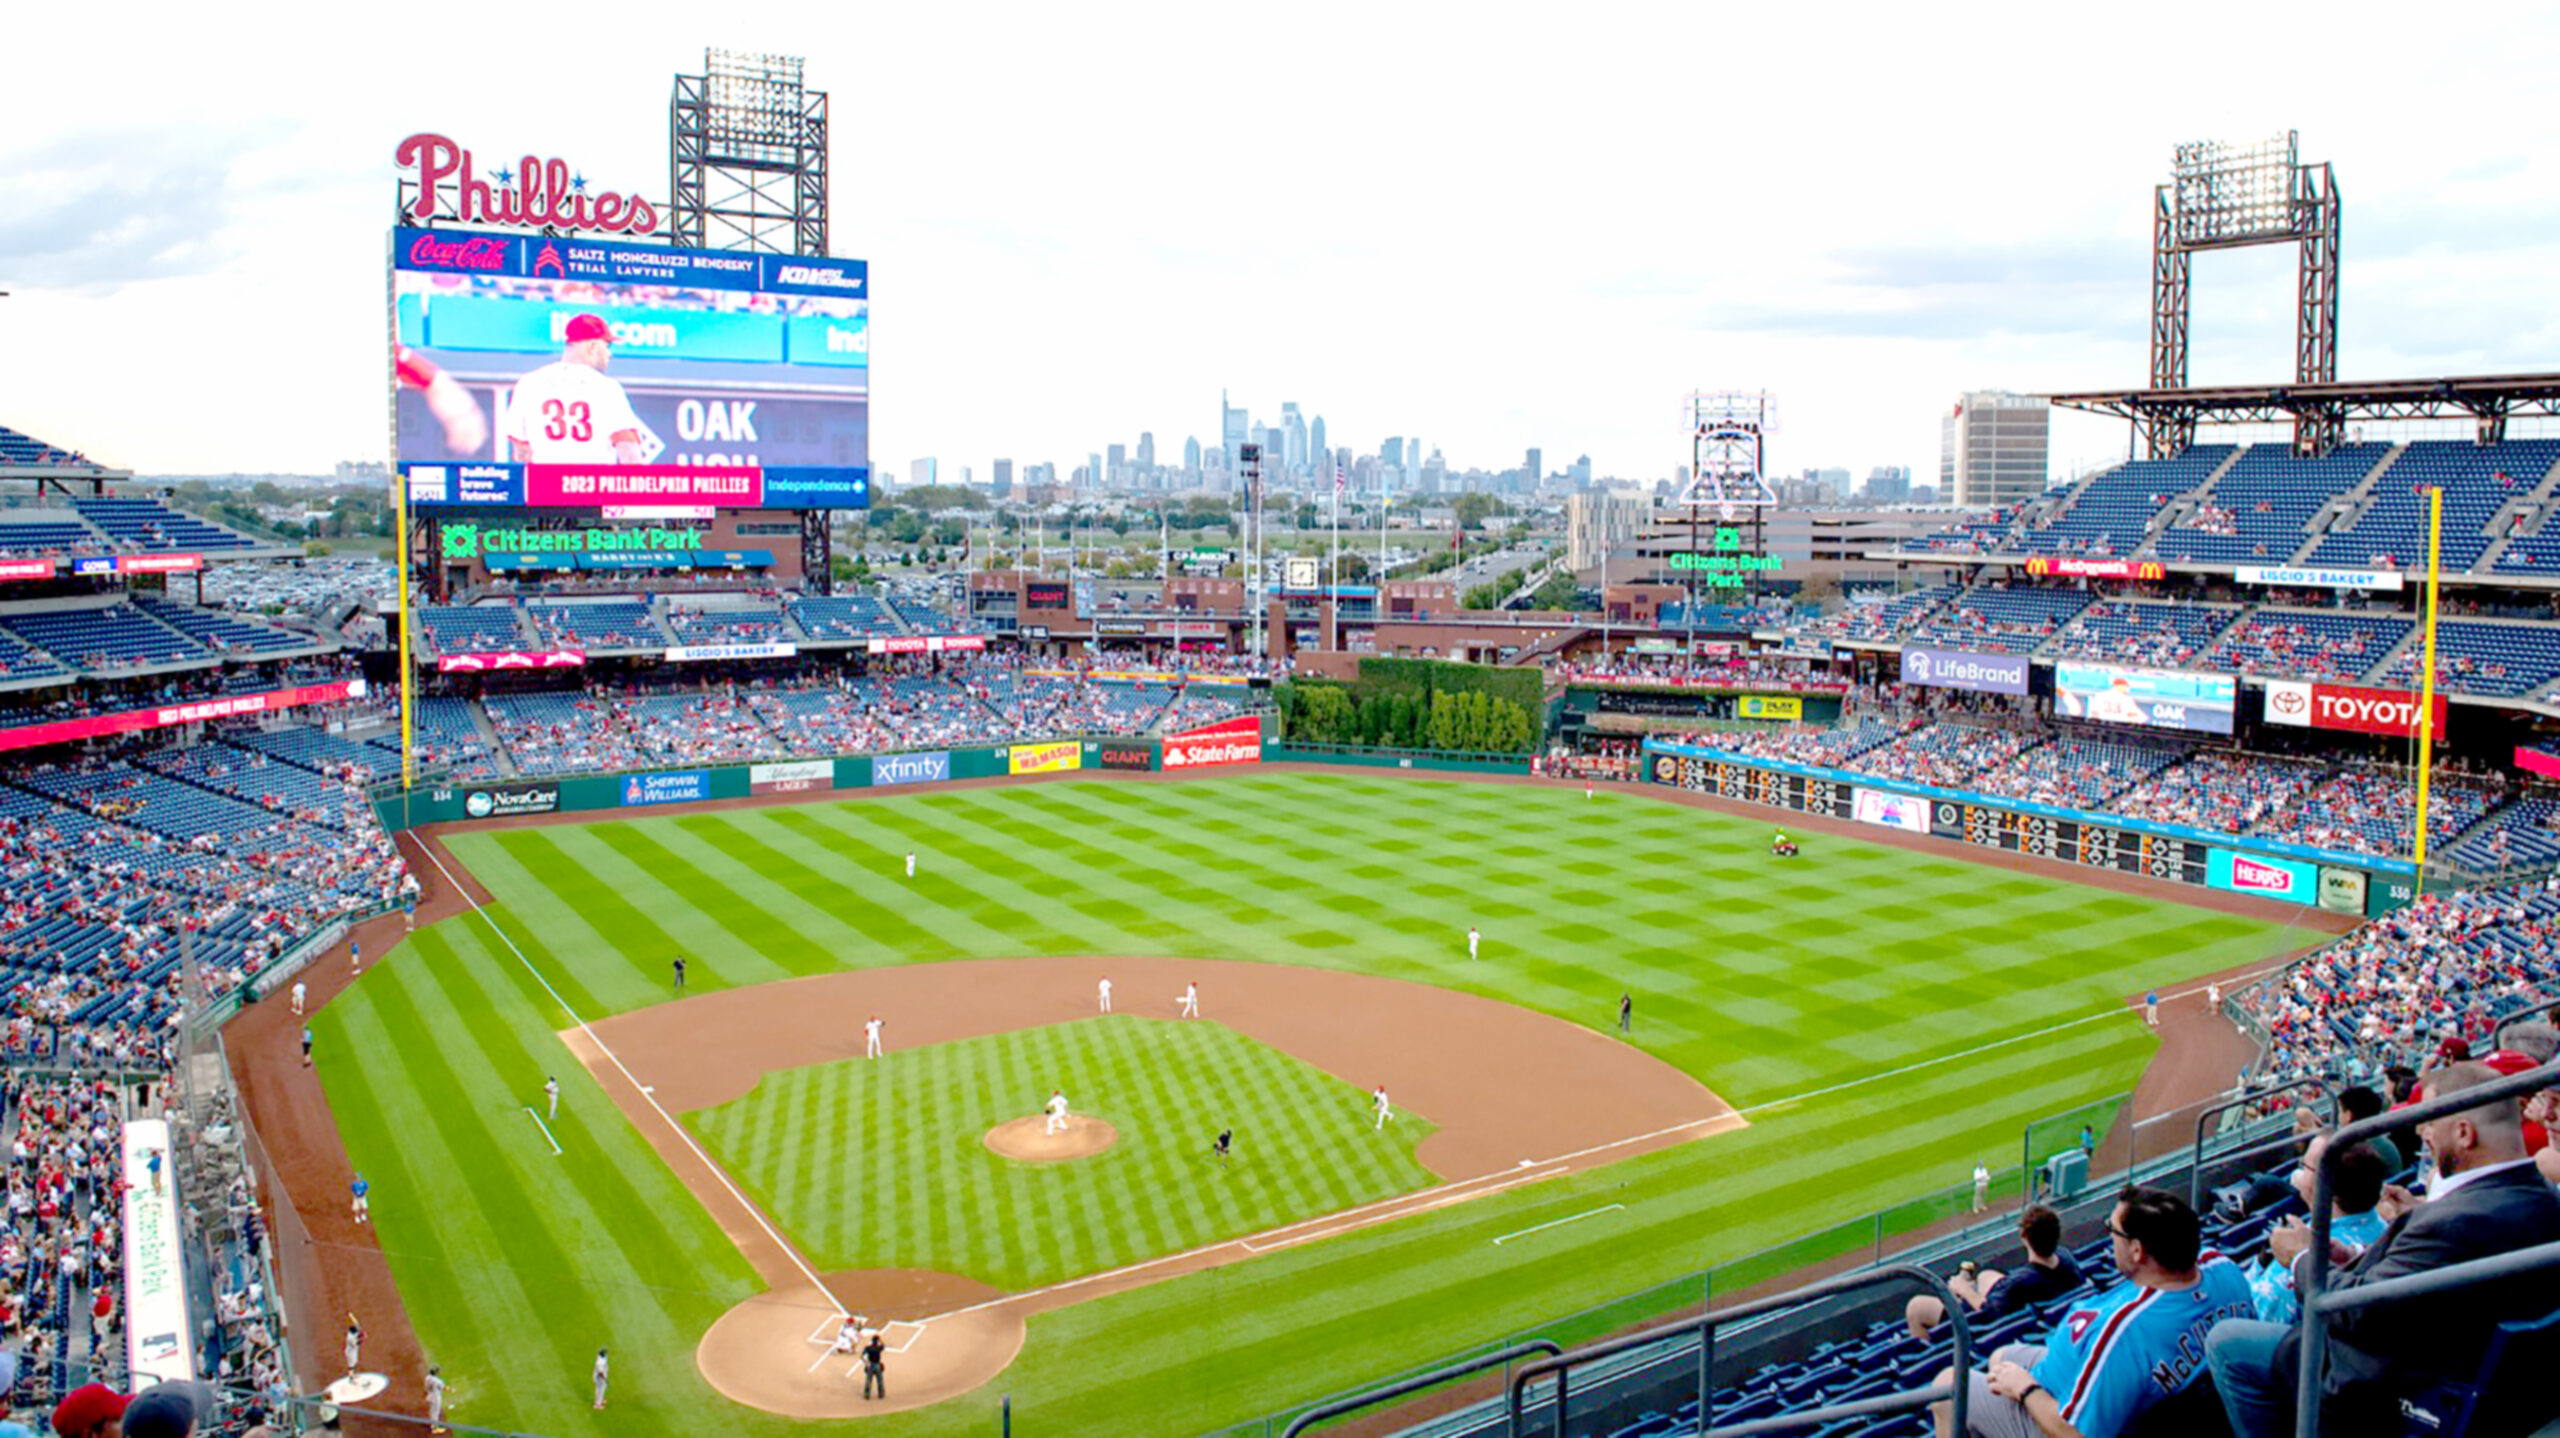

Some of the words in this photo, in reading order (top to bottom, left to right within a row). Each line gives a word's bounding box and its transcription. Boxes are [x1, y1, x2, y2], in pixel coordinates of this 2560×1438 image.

[395, 133, 659, 236] Phillies
[410, 234, 509, 269] Coca-Cola
[568, 247, 605, 262] SALTZ
[692, 256, 754, 272] BENDESKY
[568, 262, 608, 274] TRIAL
[616, 264, 676, 279] LAWYERS
[542, 399, 592, 442] 33
[676, 399, 758, 442] OAK
[562, 475, 595, 493] 2023
[599, 475, 689, 493] PHILADELPHIA
[693, 476, 750, 493] PHILLIES
[768, 479, 850, 493] Independence
[483, 528, 582, 551] Citizens
[587, 528, 647, 551] Bank
[650, 526, 702, 550] Park
[1669, 552, 1738, 571] Citizens
[1740, 552, 1783, 571] Bank
[2058, 560, 2128, 576] McDonald's
[1707, 570, 1745, 588] Park
[2260, 569, 2314, 584] LISCIO'S
[2319, 571, 2376, 586] BAKERY
[1030, 591, 1065, 601] GIANT
[888, 639, 925, 650] TOYOTA
[945, 637, 983, 648] TOYOTA
[1935, 659, 2021, 685] LifeBrand
[2152, 703, 2186, 721] OAK
[1102, 751, 1150, 763] GIANT
[1187, 745, 1224, 764] State
[1225, 743, 1260, 760] Farm
[878, 756, 945, 783] xfinity
[645, 775, 700, 789] SHERWIN
[776, 780, 810, 792] LAGER
[494, 789, 558, 806] NovaCare
